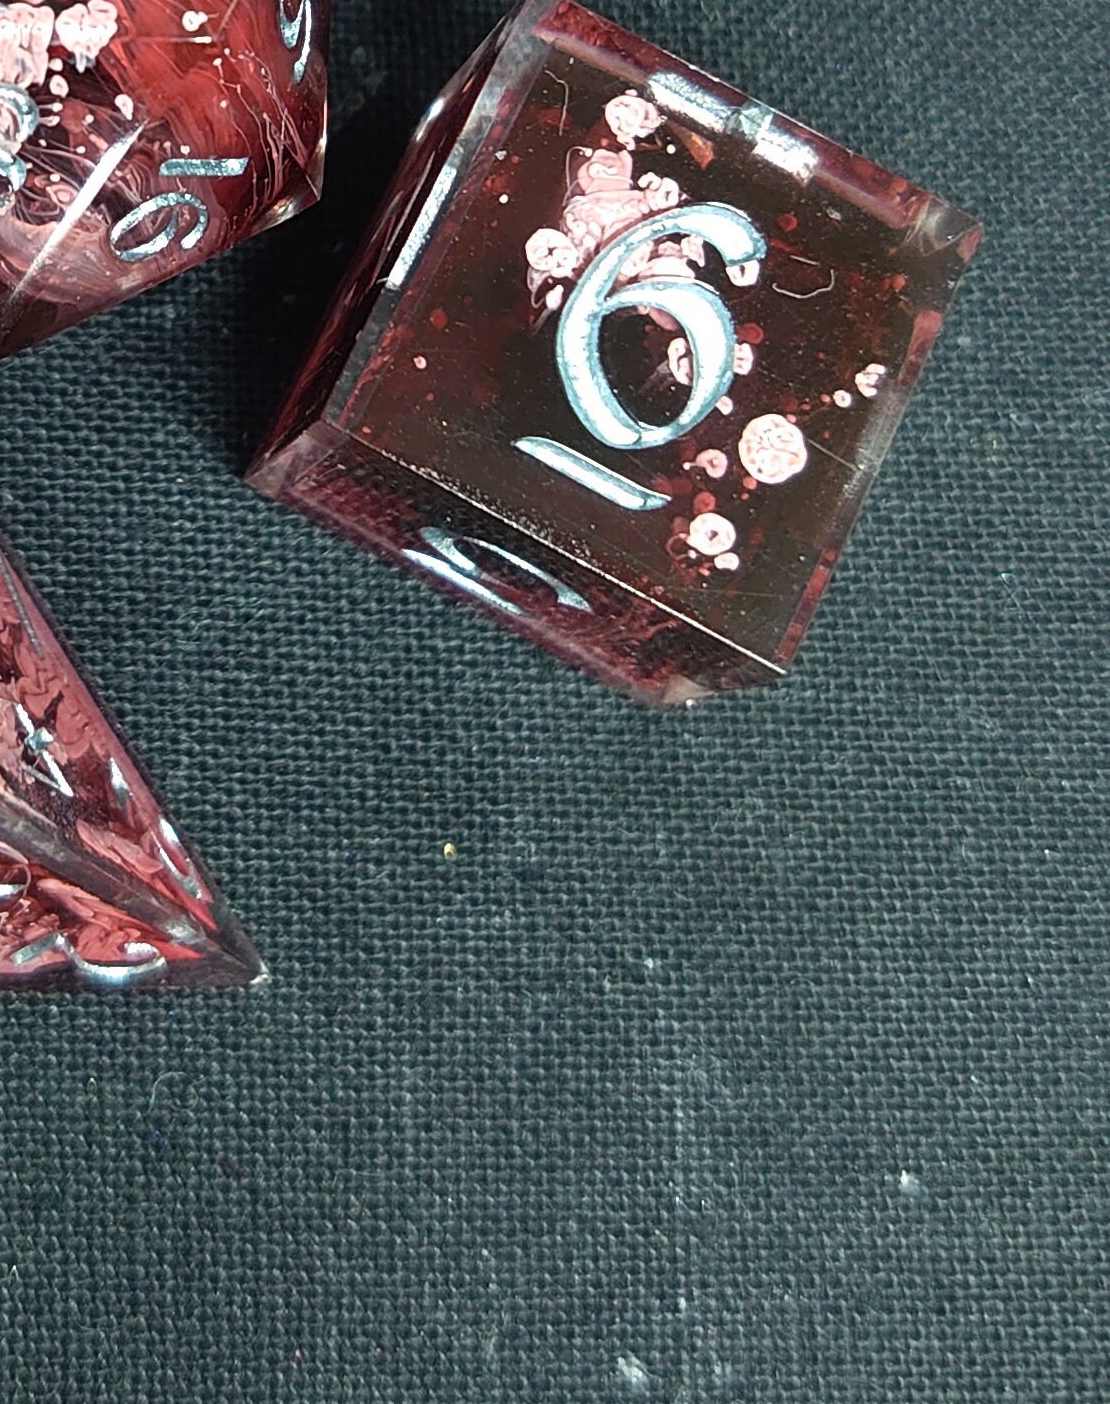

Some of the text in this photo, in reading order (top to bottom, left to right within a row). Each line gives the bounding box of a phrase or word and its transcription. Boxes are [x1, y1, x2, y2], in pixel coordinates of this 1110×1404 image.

[109, 157, 250, 263] 16
[512, 200, 768, 512] 6
[14, 701, 74, 799] 4
